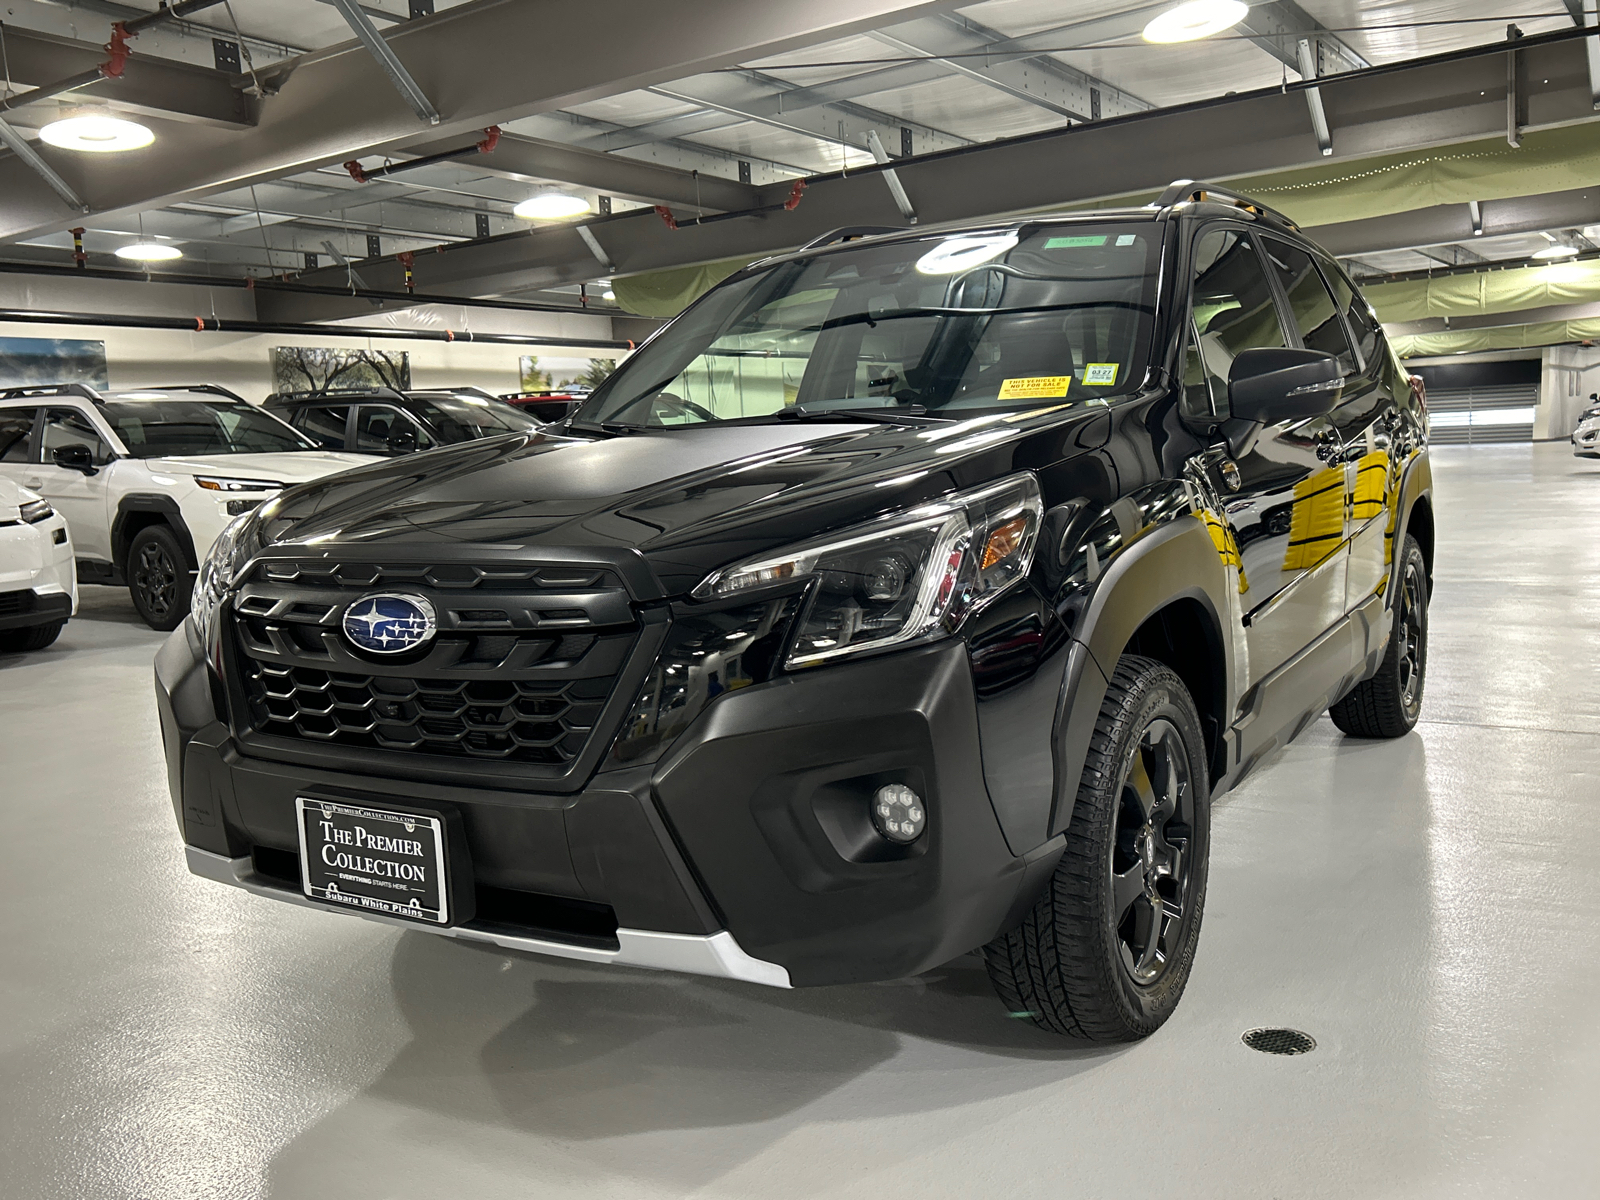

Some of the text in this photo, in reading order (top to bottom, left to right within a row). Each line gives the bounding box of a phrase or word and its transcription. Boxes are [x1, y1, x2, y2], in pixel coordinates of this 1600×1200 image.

[319, 820, 423, 856] THE PREMIER
[321, 844, 425, 881] COLLECTION
[339, 872, 372, 884] EVERYTHING
[372, 879, 392, 888] STARTS
[325, 891, 423, 917] Subaru White Plains
